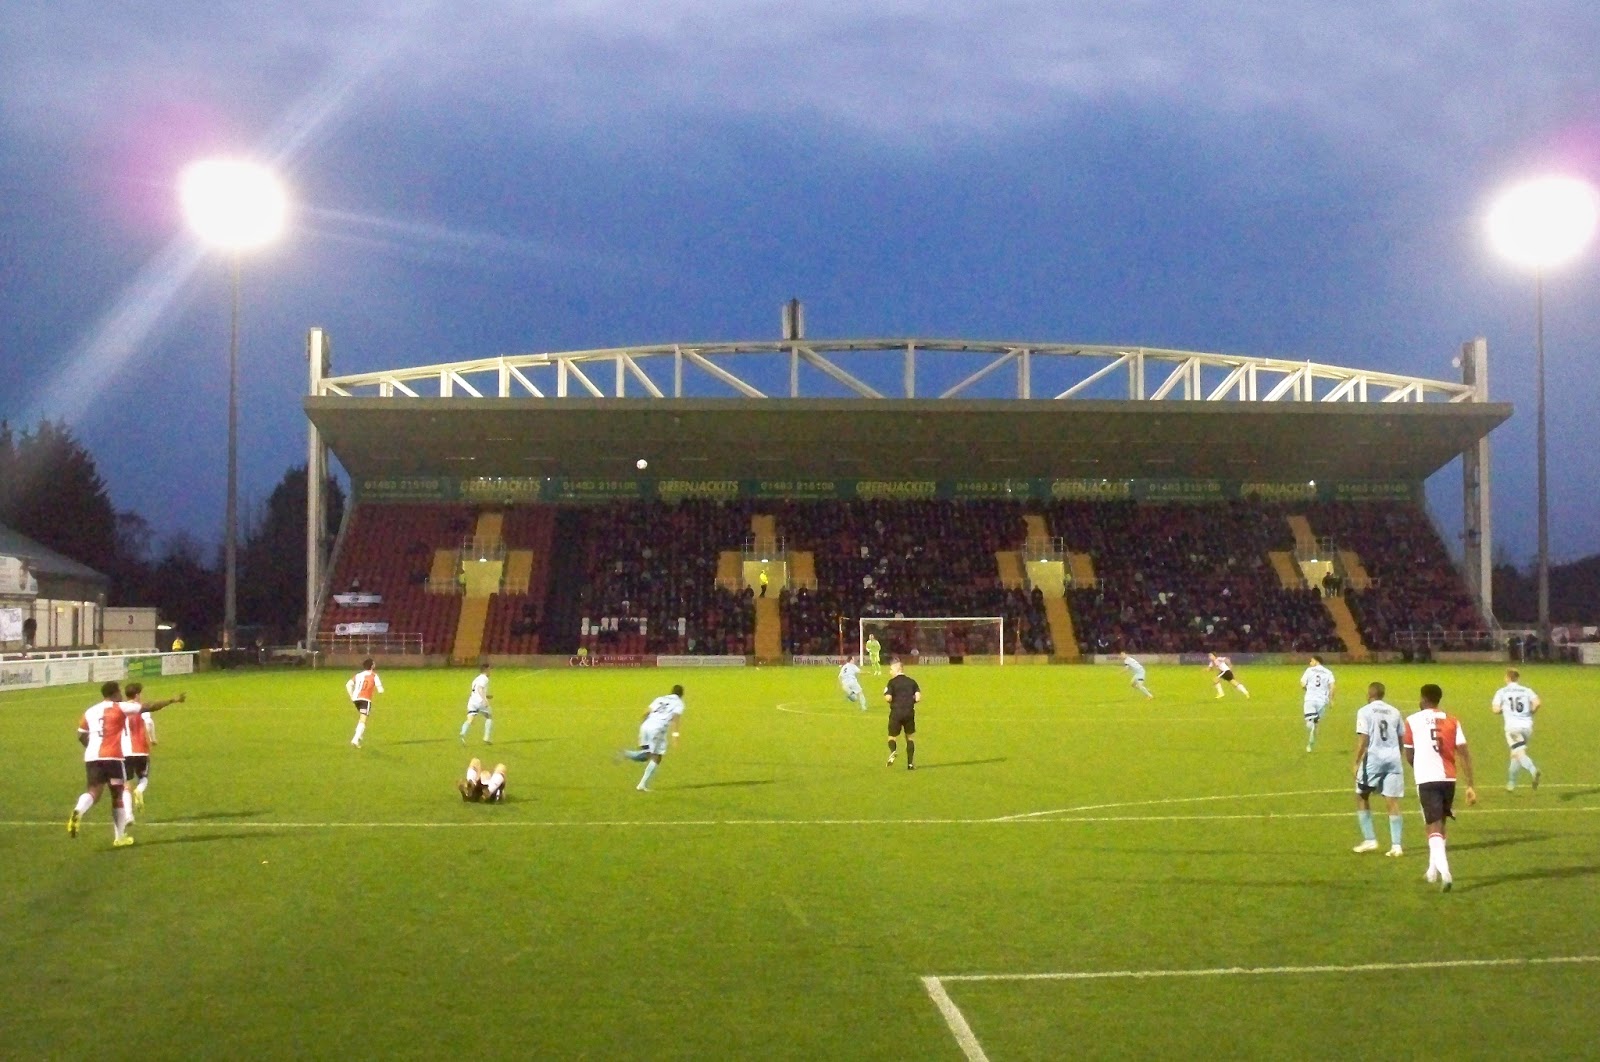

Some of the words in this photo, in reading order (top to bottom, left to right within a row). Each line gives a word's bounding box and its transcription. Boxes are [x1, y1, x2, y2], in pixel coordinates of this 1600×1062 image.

[128, 614, 134, 625] 3
[1315, 675, 1322, 687] 3
[1508, 696, 1524, 713] 16
[1378, 719, 1389, 742] 8
[1430, 728, 1444, 753] 5
